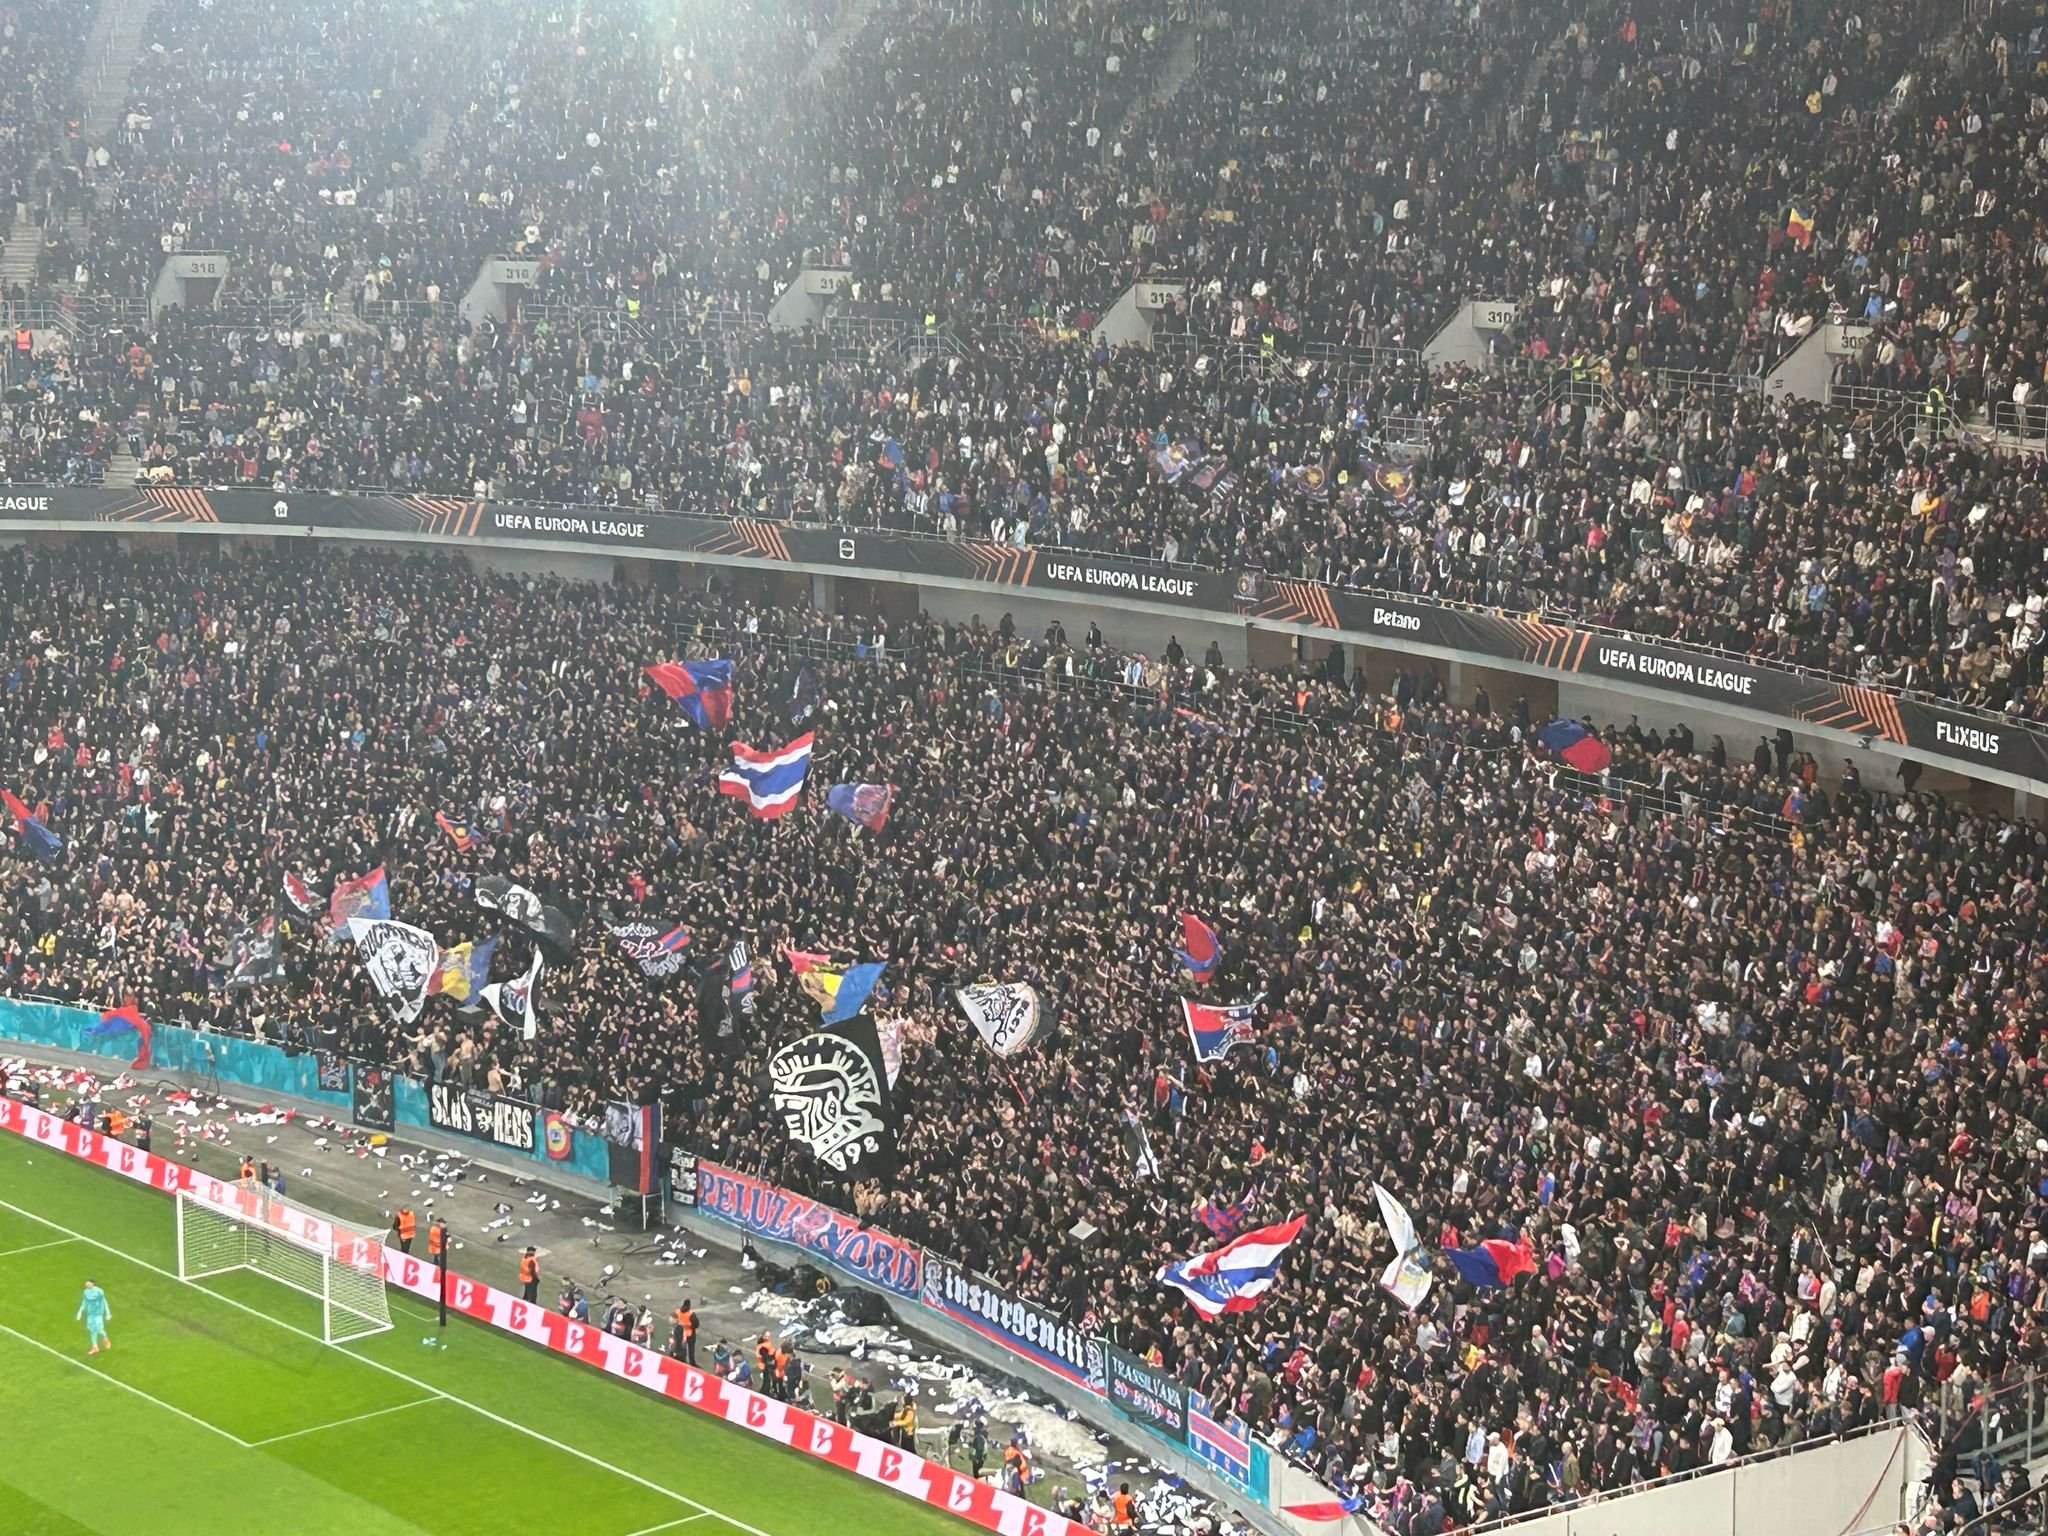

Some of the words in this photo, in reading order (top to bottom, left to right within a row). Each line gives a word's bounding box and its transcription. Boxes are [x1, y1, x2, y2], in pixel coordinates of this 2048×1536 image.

[494, 513, 532, 530] UEFA
[534, 516, 589, 534] EUROPA
[592, 520, 645, 538] LEAGUE
[1047, 563, 1083, 582] UEFA
[1085, 568, 1139, 590] EUROPA
[1141, 575, 1194, 597] LEAGUE
[1373, 607, 1421, 631] Betano
[1599, 647, 1636, 671] UEFA
[1639, 655, 1694, 683] EUROPA
[1697, 667, 1752, 695] LEAGUE
[814, 1221, 919, 1293] NORD
